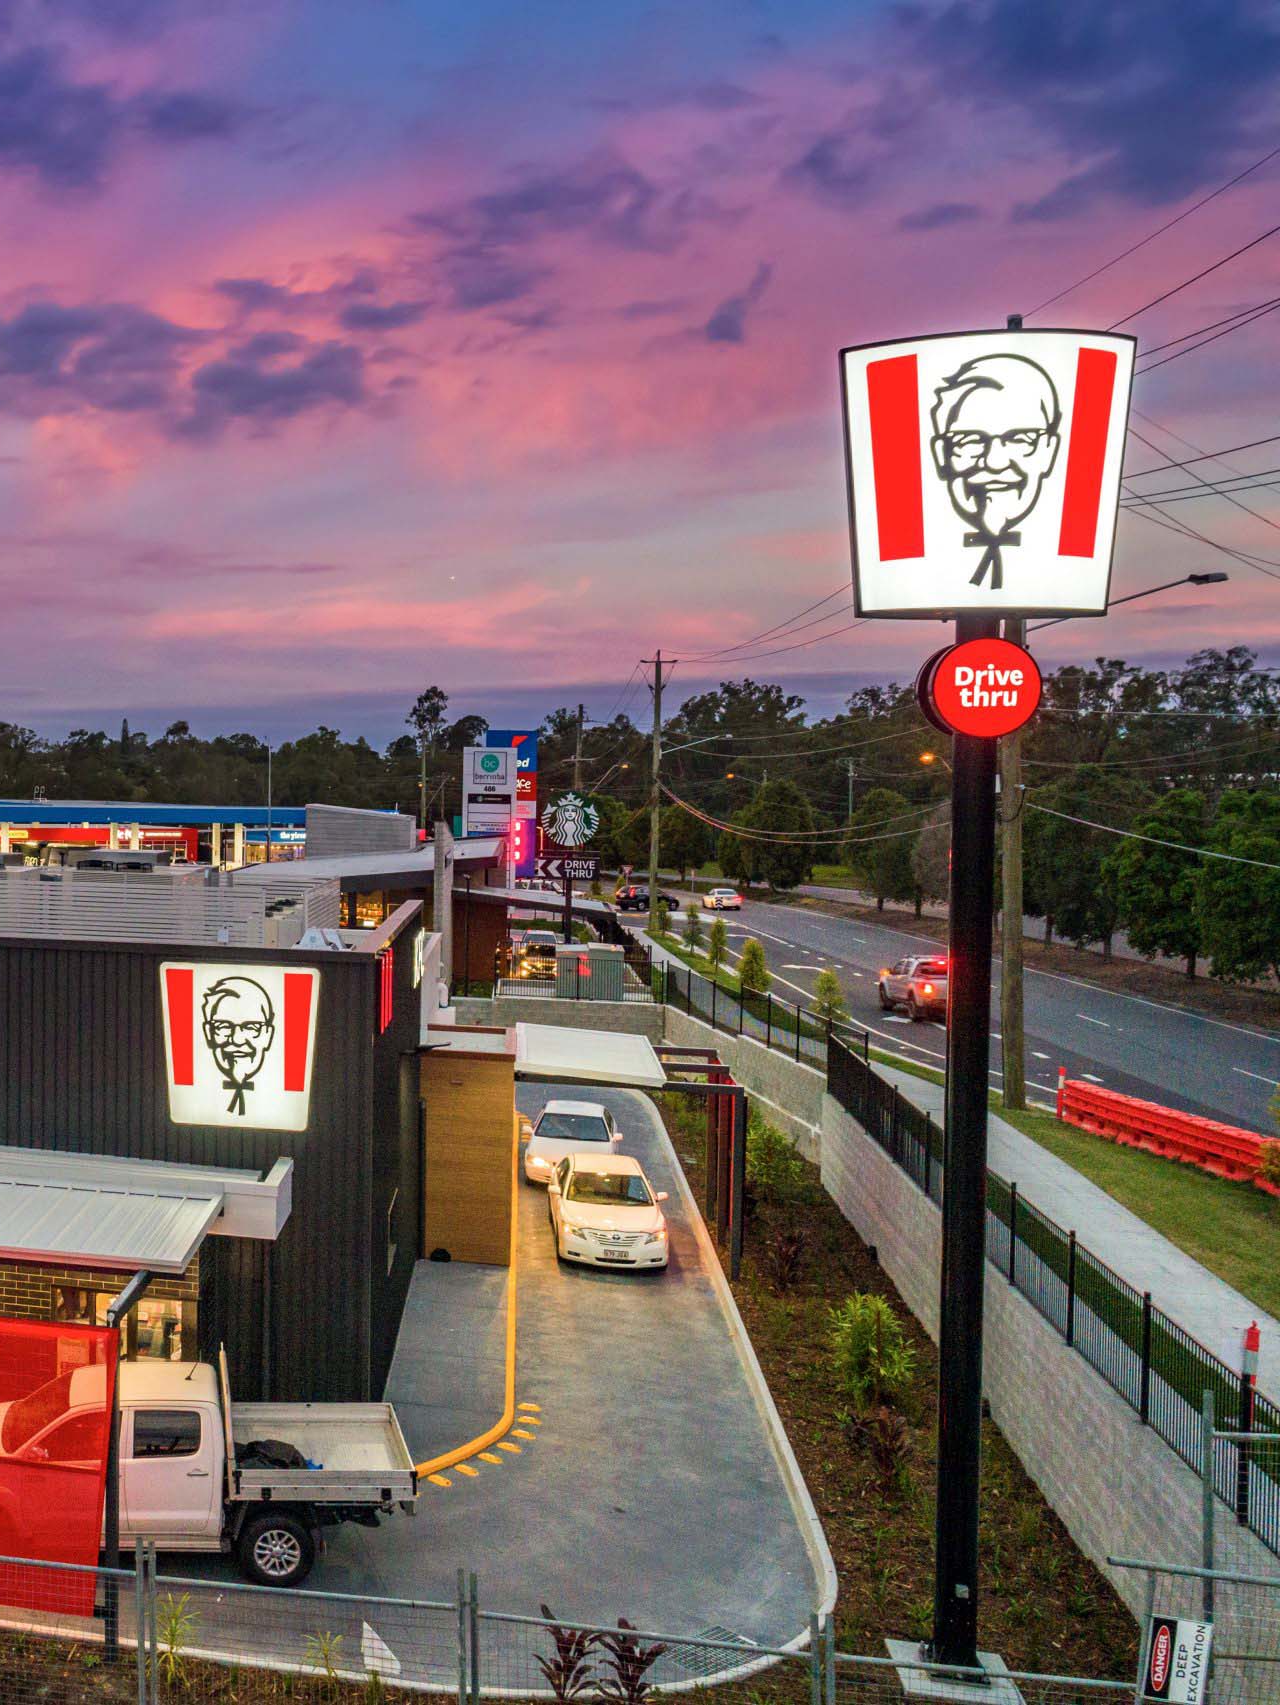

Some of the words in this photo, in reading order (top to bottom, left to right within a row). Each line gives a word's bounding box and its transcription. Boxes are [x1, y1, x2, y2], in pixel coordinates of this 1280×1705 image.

[955, 664, 1024, 686] Drive
[960, 684, 1018, 707] thru
[564, 860, 596, 869] DRIVE
[564, 869, 593, 878] THRU
[1154, 1634, 1168, 1682] DANGER
[1176, 1644, 1188, 1679] DEEP
[1187, 1625, 1206, 1703] EXCAVATION
